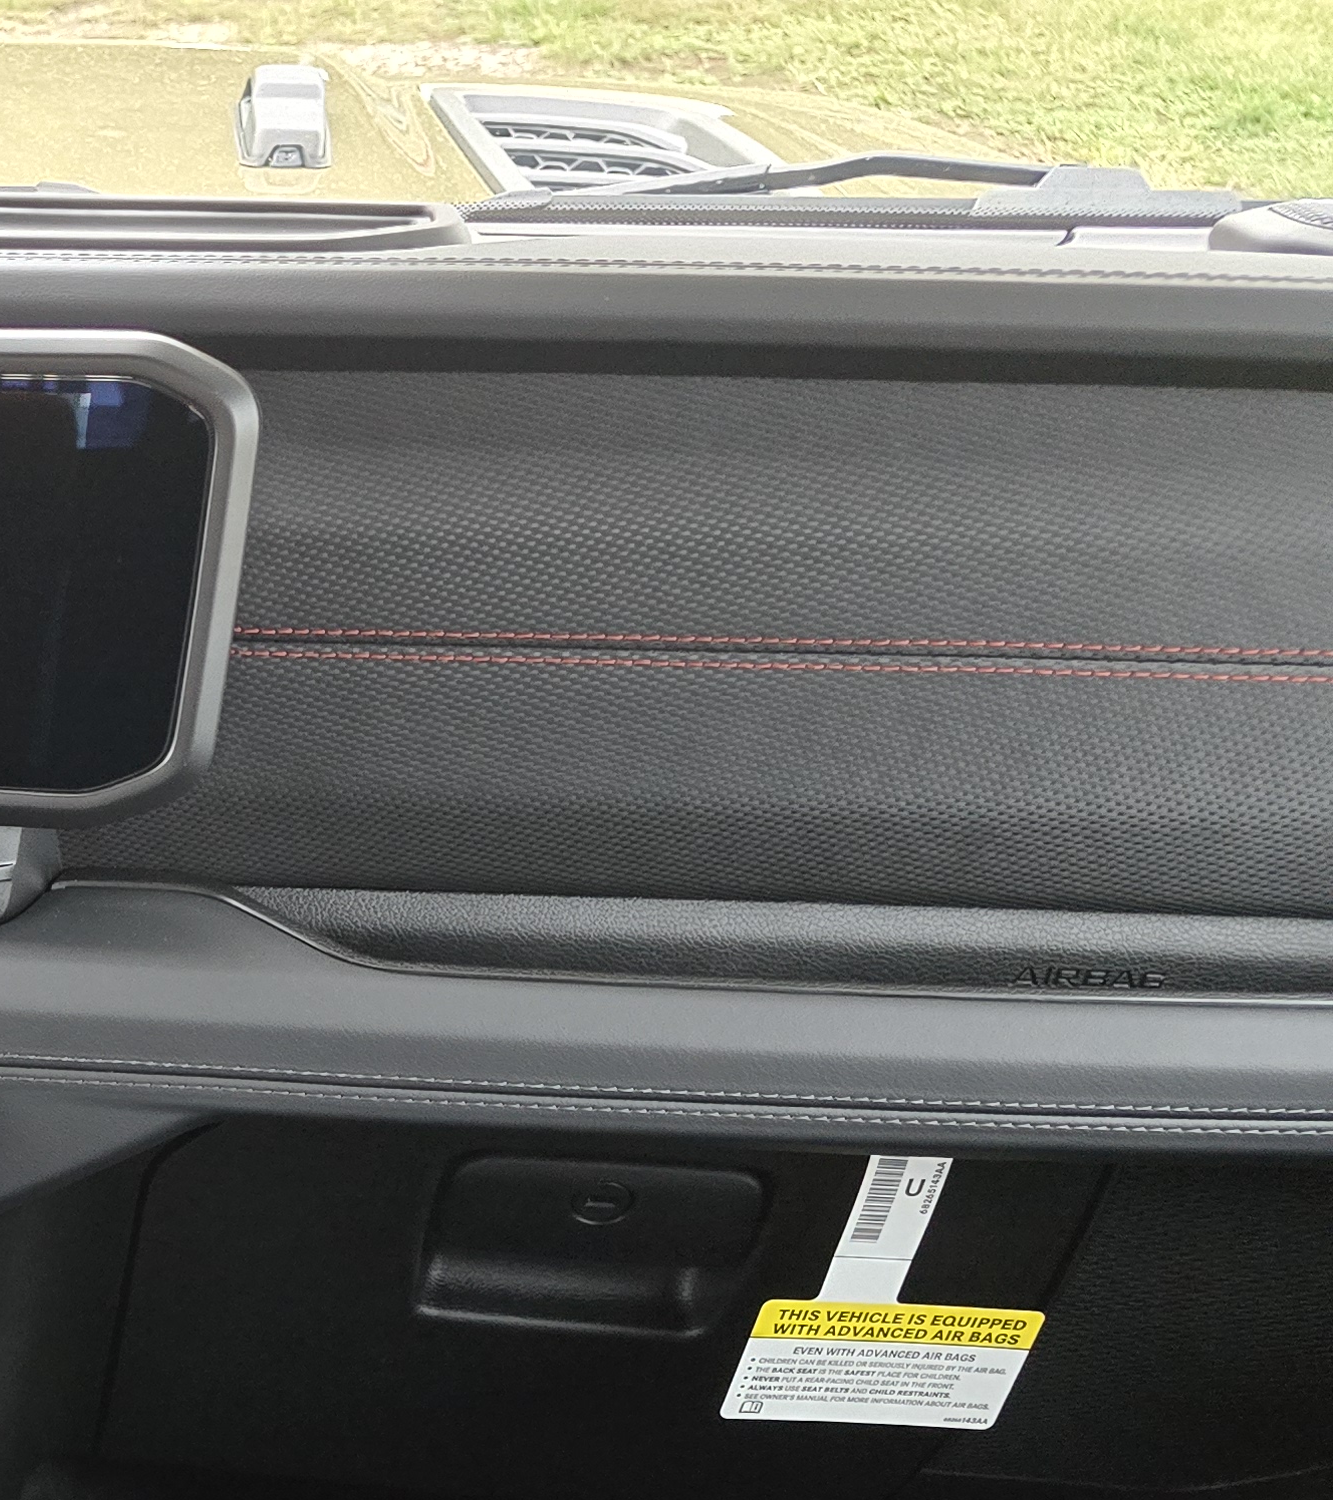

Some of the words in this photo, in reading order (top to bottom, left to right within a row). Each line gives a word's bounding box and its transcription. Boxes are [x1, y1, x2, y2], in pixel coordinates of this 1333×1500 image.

[1010, 966, 1167, 990] AIRBAG
[905, 1178, 926, 1196] U
[779, 1309, 821, 1321] THIS
[825, 1310, 904, 1324] VEHICLE
[907, 1313, 928, 1325] IS
[930, 1315, 1028, 1331] EQUIPPED
[773, 1323, 822, 1336] WITH
[823, 1325, 928, 1340] ADVANCED
[930, 1329, 965, 1342] AIR
[967, 1331, 1021, 1345] BAGS
[793, 1346, 823, 1356] EVEN
[826, 1347, 856, 1357] WITH
[856, 1348, 921, 1359] ADVANCED
[921, 1351, 943, 1361] AIR
[944, 1352, 977, 1363] BAGS
[755, 1366, 770, 1374] THE
[771, 1366, 795, 1374] BACK
[796, 1367, 818, 1375] SEAT
[844, 1369, 876, 1377] SAFEST
[877, 1371, 902, 1379] PLACE
[902, 1372, 919, 1380] FOR
[920, 1373, 961, 1381] CHILDREN.
[758, 1357, 797, 1366] CHILDREN
[798, 1358, 815, 1366] CAN
[827, 1359, 855, 1367] KILLED
[855, 1360, 868, 1368] OR
[868, 1361, 912, 1370] SERIOUSLY
[911, 1362, 944, 1371] INJURED
[945, 1364, 957, 1372] BY
[957, 1365, 973, 1373] THE
[973, 1366, 988, 1374] AIR
[751, 1375, 780, 1383] NEVER
[781, 1376, 797, 1384] PUT
[804, 1377, 855, 1386] REAR-FACING
[855, 1379, 880, 1387] CHILD
[880, 1380, 900, 1388] SEAT
[911, 1381, 927, 1389] THE
[747, 1384, 783, 1392] ALWAYS
[784, 1385, 801, 1393] USE
[823, 1386, 850, 1394] BELTS
[850, 1387, 868, 1395] AND
[868, 1388, 896, 1396] CHILD
[896, 1390, 951, 1399] RESTRAINTS.
[759, 1393, 795, 1401] OWNER'S
[796, 1394, 829, 1403] MANUAL
[870, 1398, 924, 1407] INFORMATION
[924, 1400, 952, 1408] ABOUT
